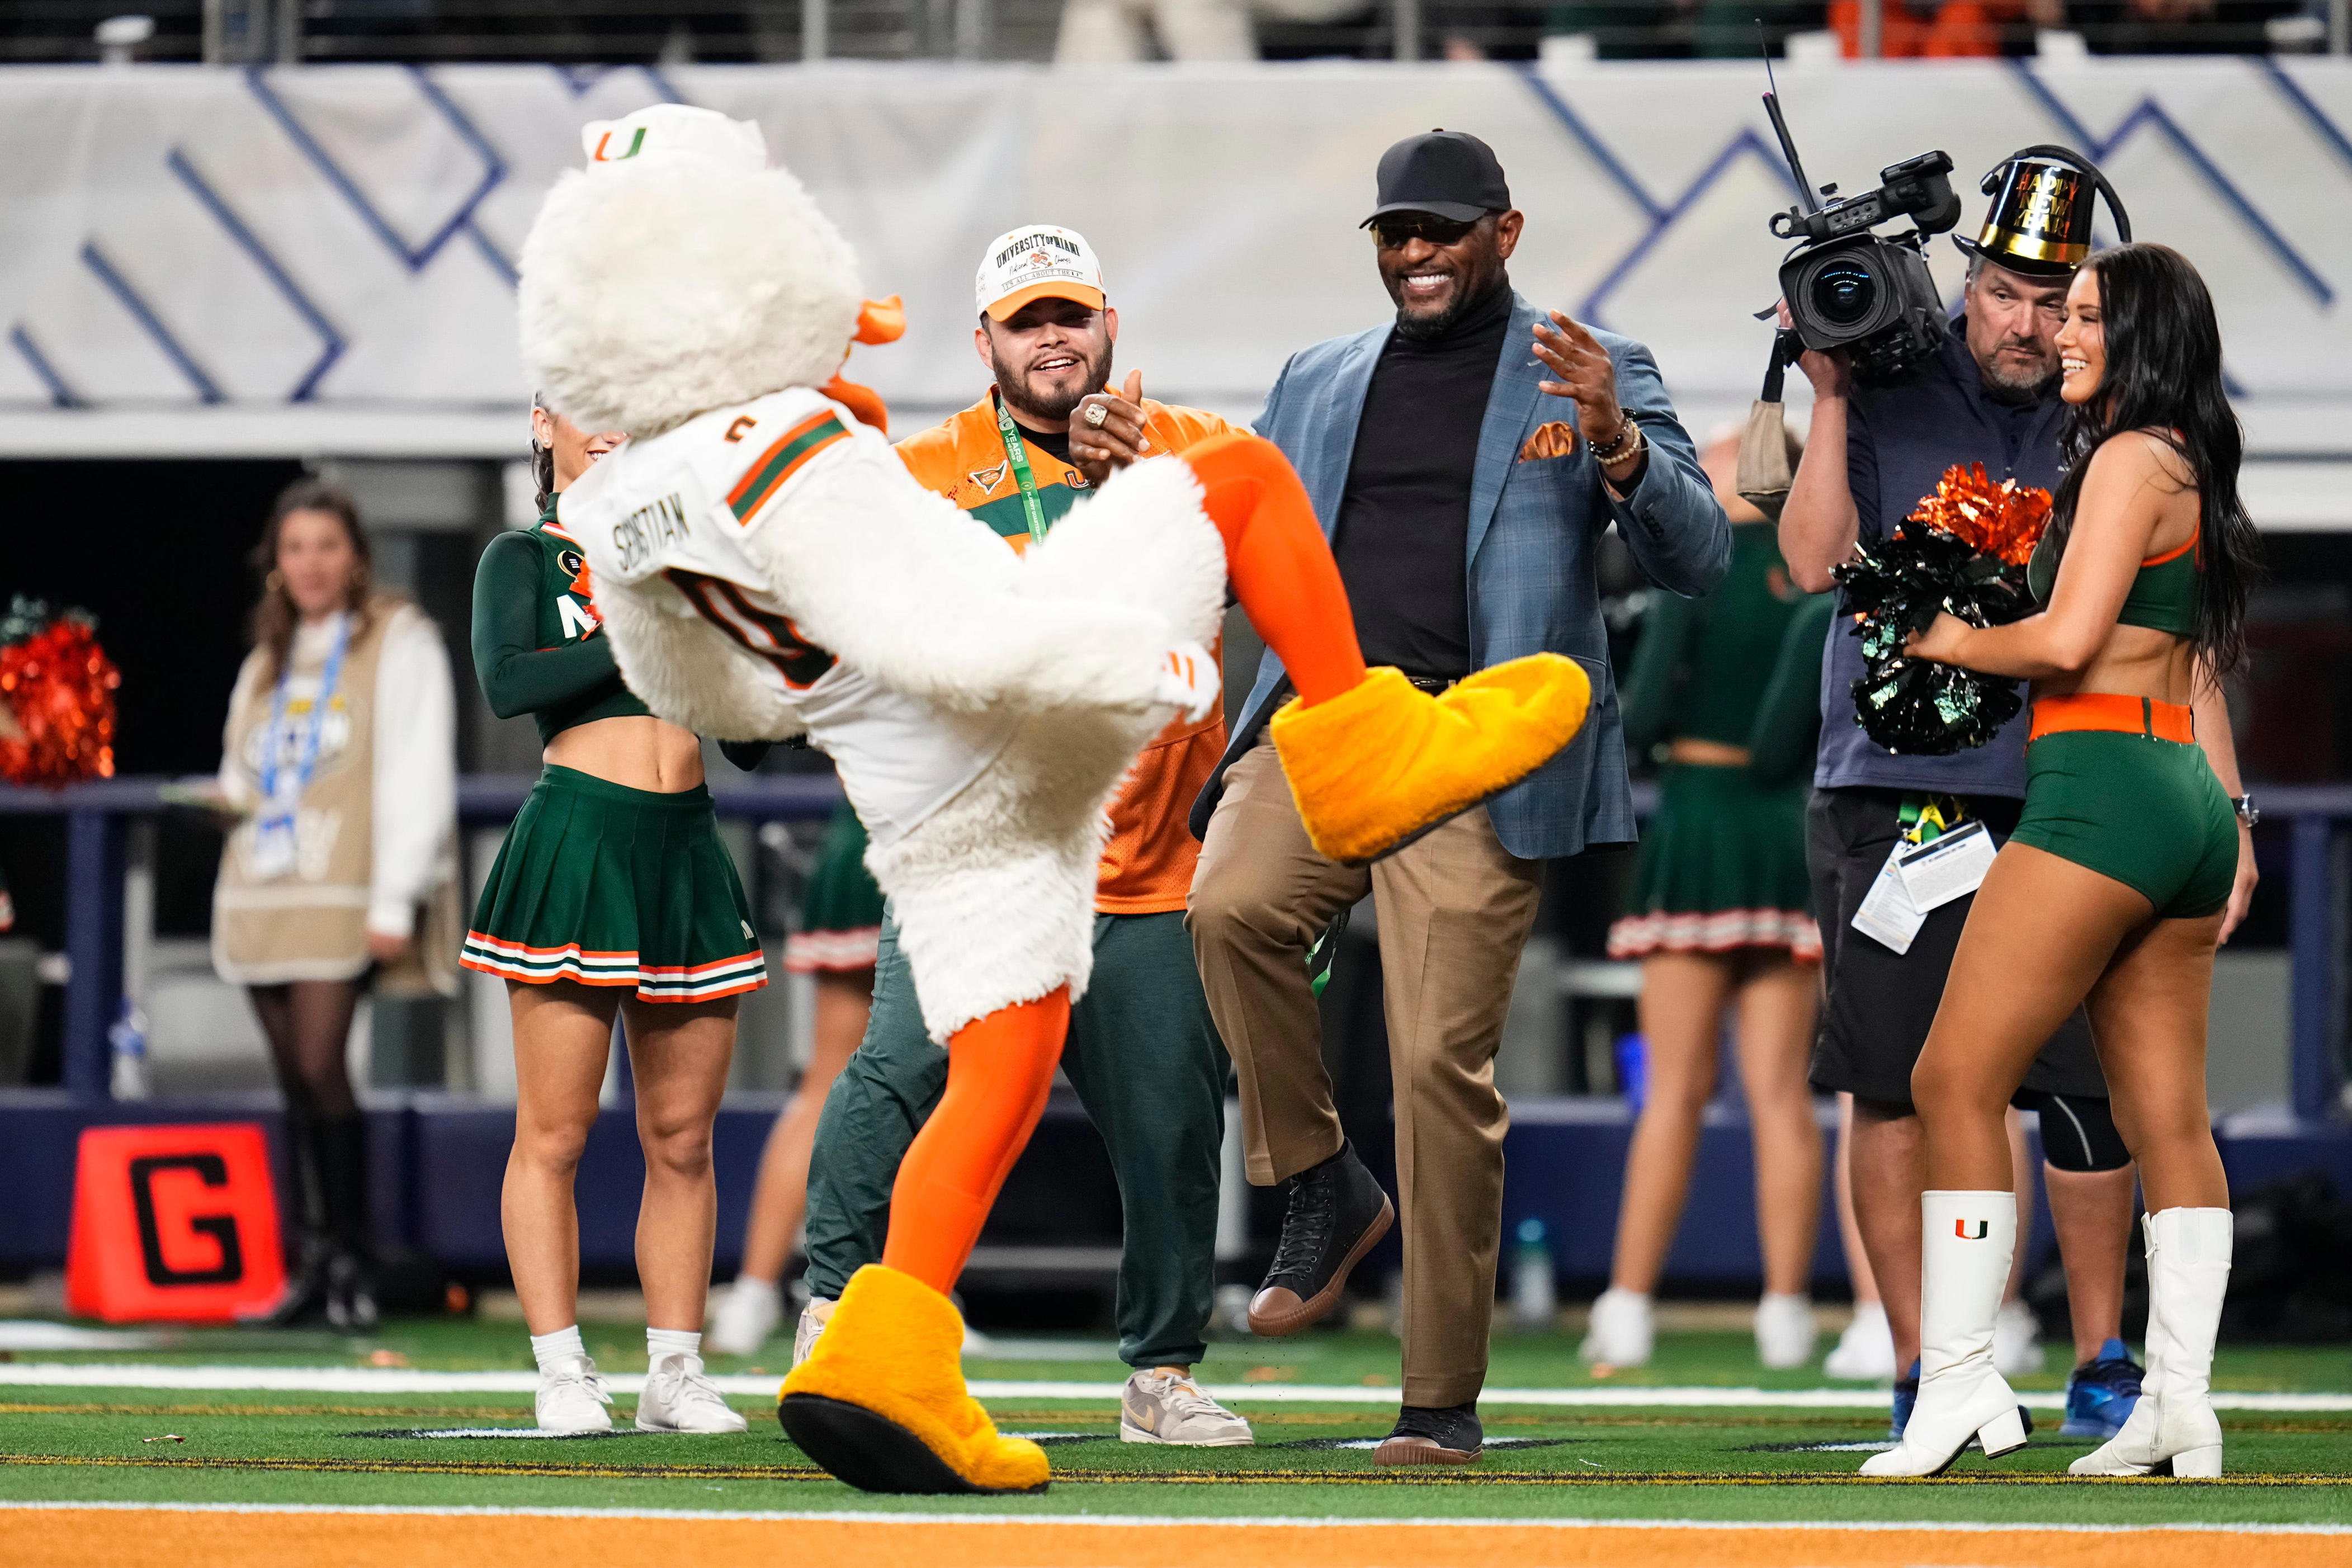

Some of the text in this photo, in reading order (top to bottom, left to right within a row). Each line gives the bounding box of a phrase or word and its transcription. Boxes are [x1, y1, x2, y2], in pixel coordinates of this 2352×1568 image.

[594, 127, 647, 162] U
[2016, 173, 2080, 201] HAPPY
[1824, 204, 1843, 215] SONY
[2019, 192, 2070, 216] NEW
[996, 234, 1080, 268] UNIVERSITY OF MIAMI
[1016, 274, 1029, 284] ALL
[1008, 429, 1023, 462] YEARS
[982, 472, 999, 483] ACC
[1026, 491, 1036, 511] PLAYOFF
[129, 1154, 244, 1286] G
[1956, 1219, 1988, 1239] U
